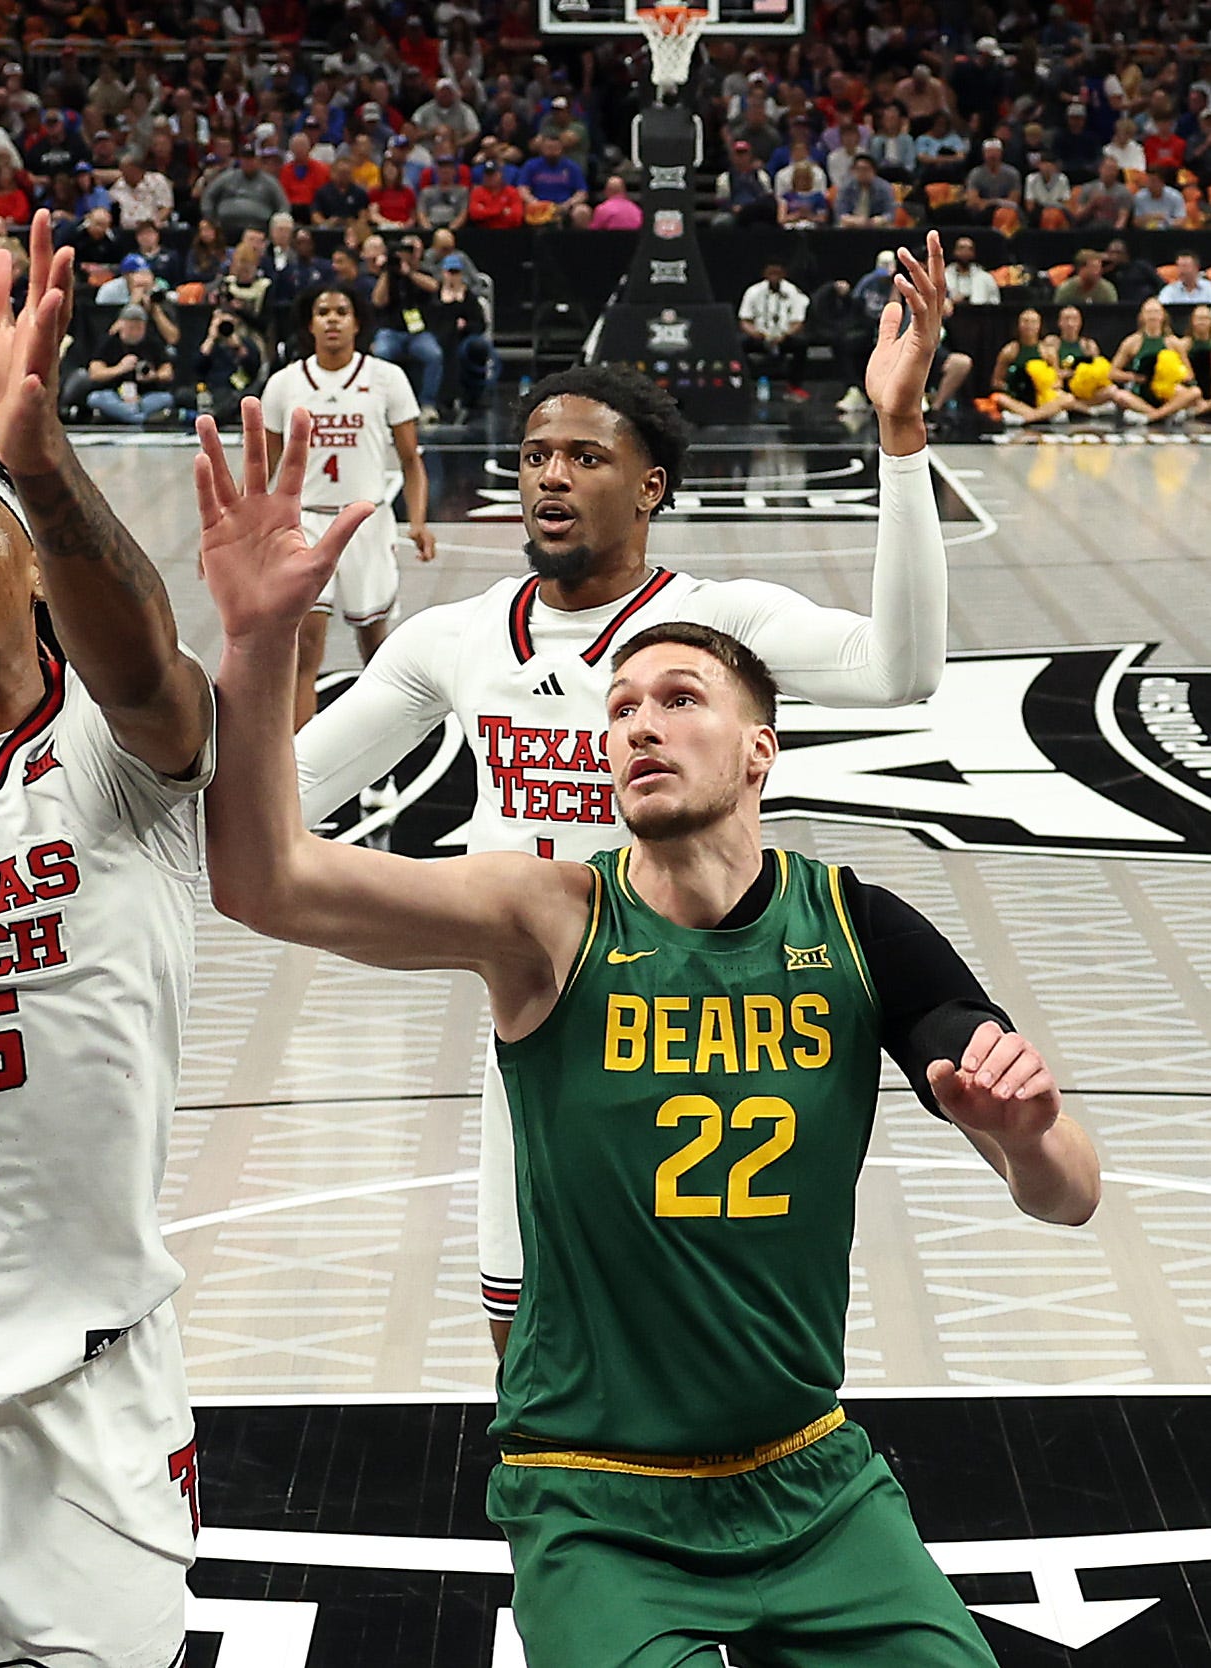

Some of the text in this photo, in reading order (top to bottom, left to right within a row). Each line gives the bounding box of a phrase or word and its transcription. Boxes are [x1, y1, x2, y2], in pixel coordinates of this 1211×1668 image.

[323, 454, 339, 482] 4
[492, 766, 616, 825] TECH
[603, 993, 832, 1074] BEARS
[654, 1094, 797, 1218] 22
